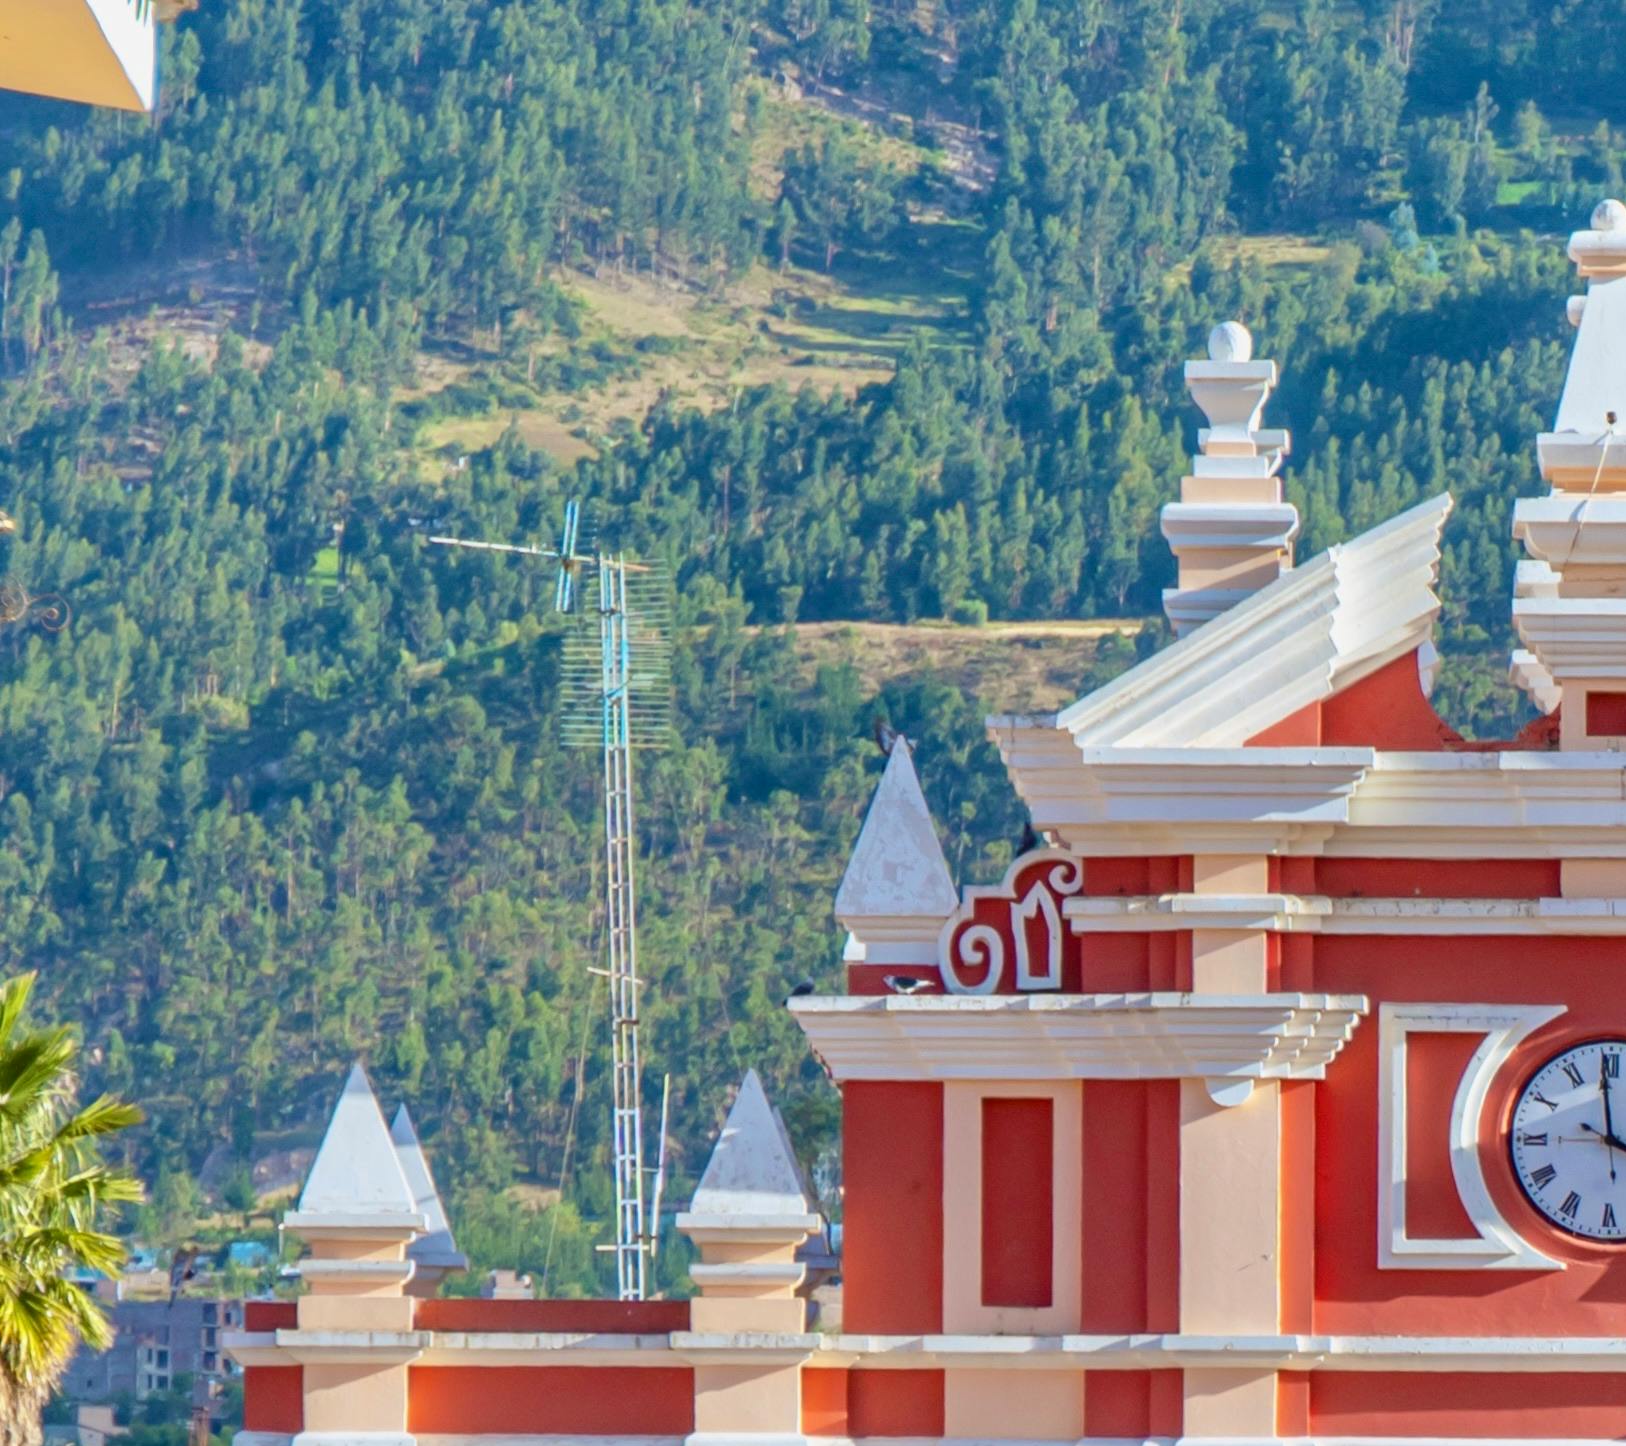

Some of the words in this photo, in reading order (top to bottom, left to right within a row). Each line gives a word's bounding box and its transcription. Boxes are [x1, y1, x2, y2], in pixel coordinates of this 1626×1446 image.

[1562, 1062, 1585, 1088] XI
[1533, 1091, 1559, 1111] X
[1523, 1132, 1548, 1146] IX
[1530, 1163, 1557, 1191] VIII
[1559, 1190, 1582, 1219] VII
[1602, 1203, 1616, 1228] VI
